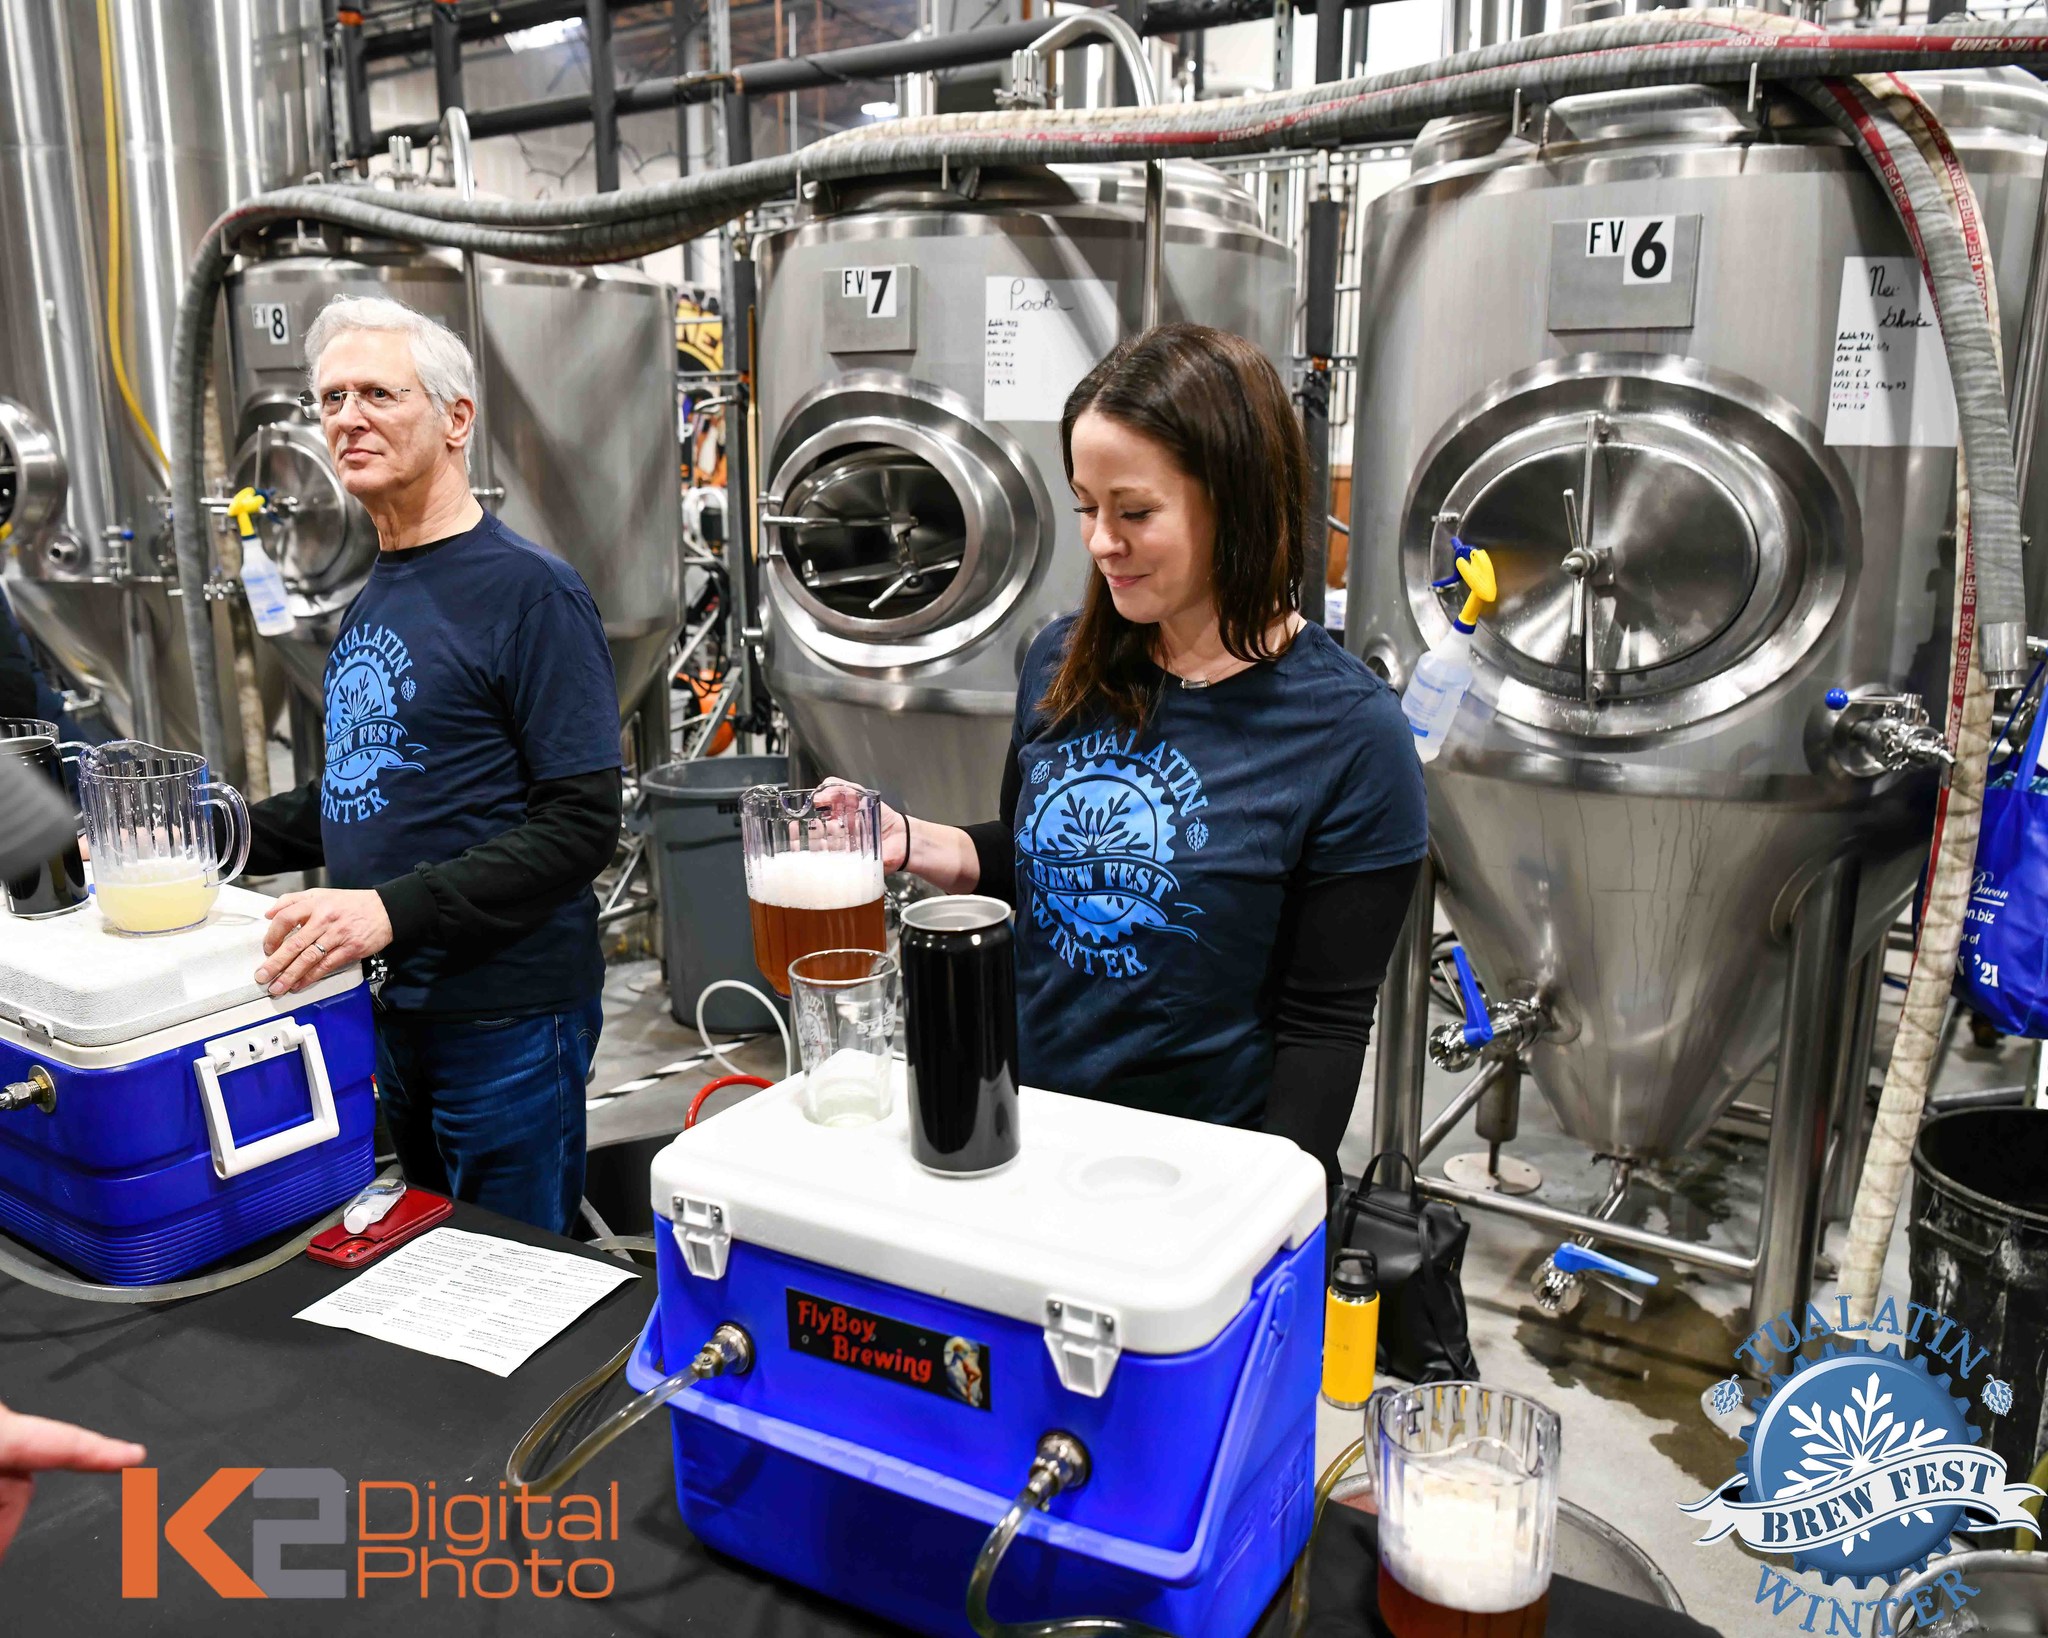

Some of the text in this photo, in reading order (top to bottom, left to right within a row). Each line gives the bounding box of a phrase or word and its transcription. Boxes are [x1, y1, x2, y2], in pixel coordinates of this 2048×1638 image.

[1754, 36, 1779, 47] PSI
[1883, 162, 1900, 186] PSI
[1942, 153, 1983, 265] REQUIREMENTS
[1590, 220, 1667, 279] FV 6
[844, 270, 892, 314] FV 7
[272, 308, 284, 339] 8
[1960, 612, 1974, 643] 2735
[330, 623, 413, 678] TUALATIN
[1954, 647, 1970, 697] SERIES
[359, 723, 403, 747] FEST
[1057, 727, 1209, 818] TUALATIN
[1032, 858, 1174, 903] BREW FEST
[1972, 870, 2009, 899] Bacon
[1032, 891, 1148, 979] WINTER
[1970, 933, 1981, 945] of
[797, 1300, 877, 1344] FlyBoy
[832, 1334, 933, 1384] Brewing
